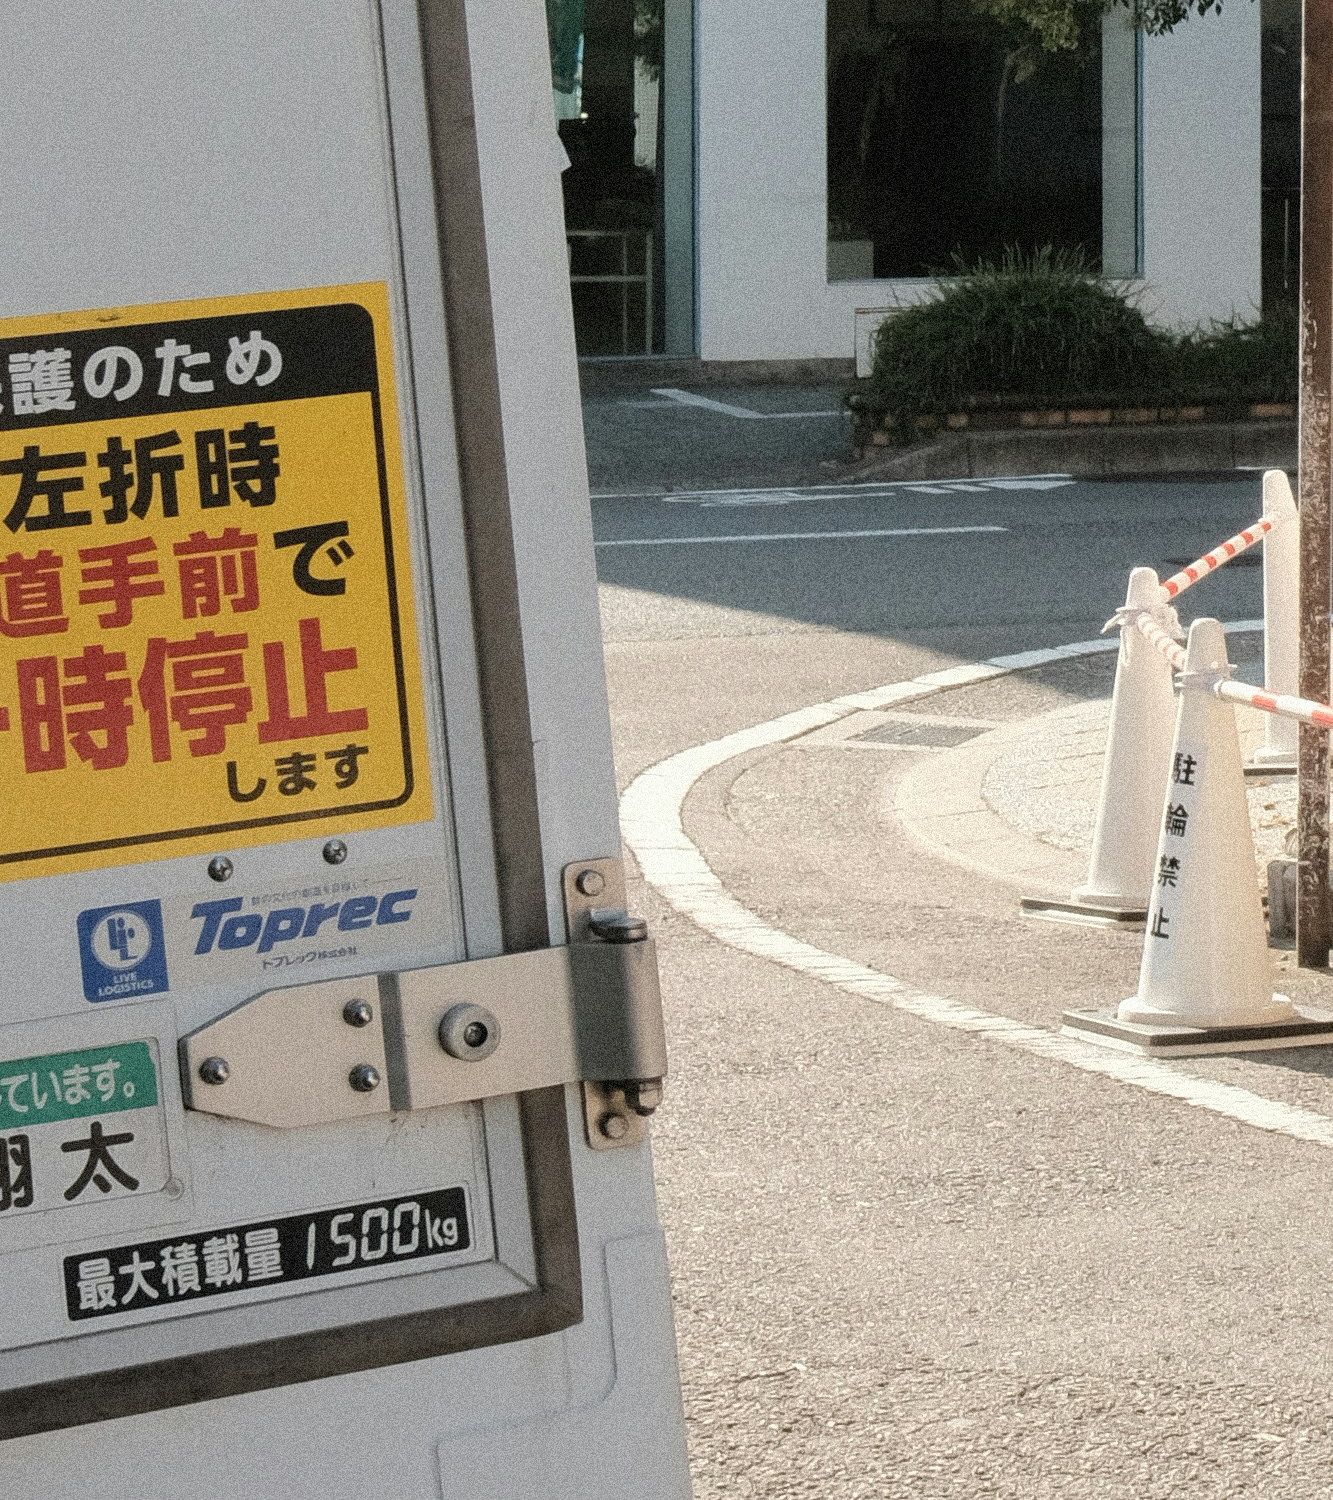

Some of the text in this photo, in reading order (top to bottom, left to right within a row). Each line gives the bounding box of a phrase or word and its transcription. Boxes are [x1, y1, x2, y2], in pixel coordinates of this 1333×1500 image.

[0, 330, 284, 417] 護のため
[0, 421, 282, 534] 左折時
[0, 617, 369, 774] 時停止
[226, 743, 369, 802] します
[1150, 751, 1198, 940] 駐輪禁止
[189, 887, 420, 956] Toprec
[97, 979, 155, 997] LOGISTICS
[112, 971, 138, 985] LIVE
[0, 1058, 136, 1114] ています。
[76, 1200, 460, 1312] 最大積載量 1500kg
